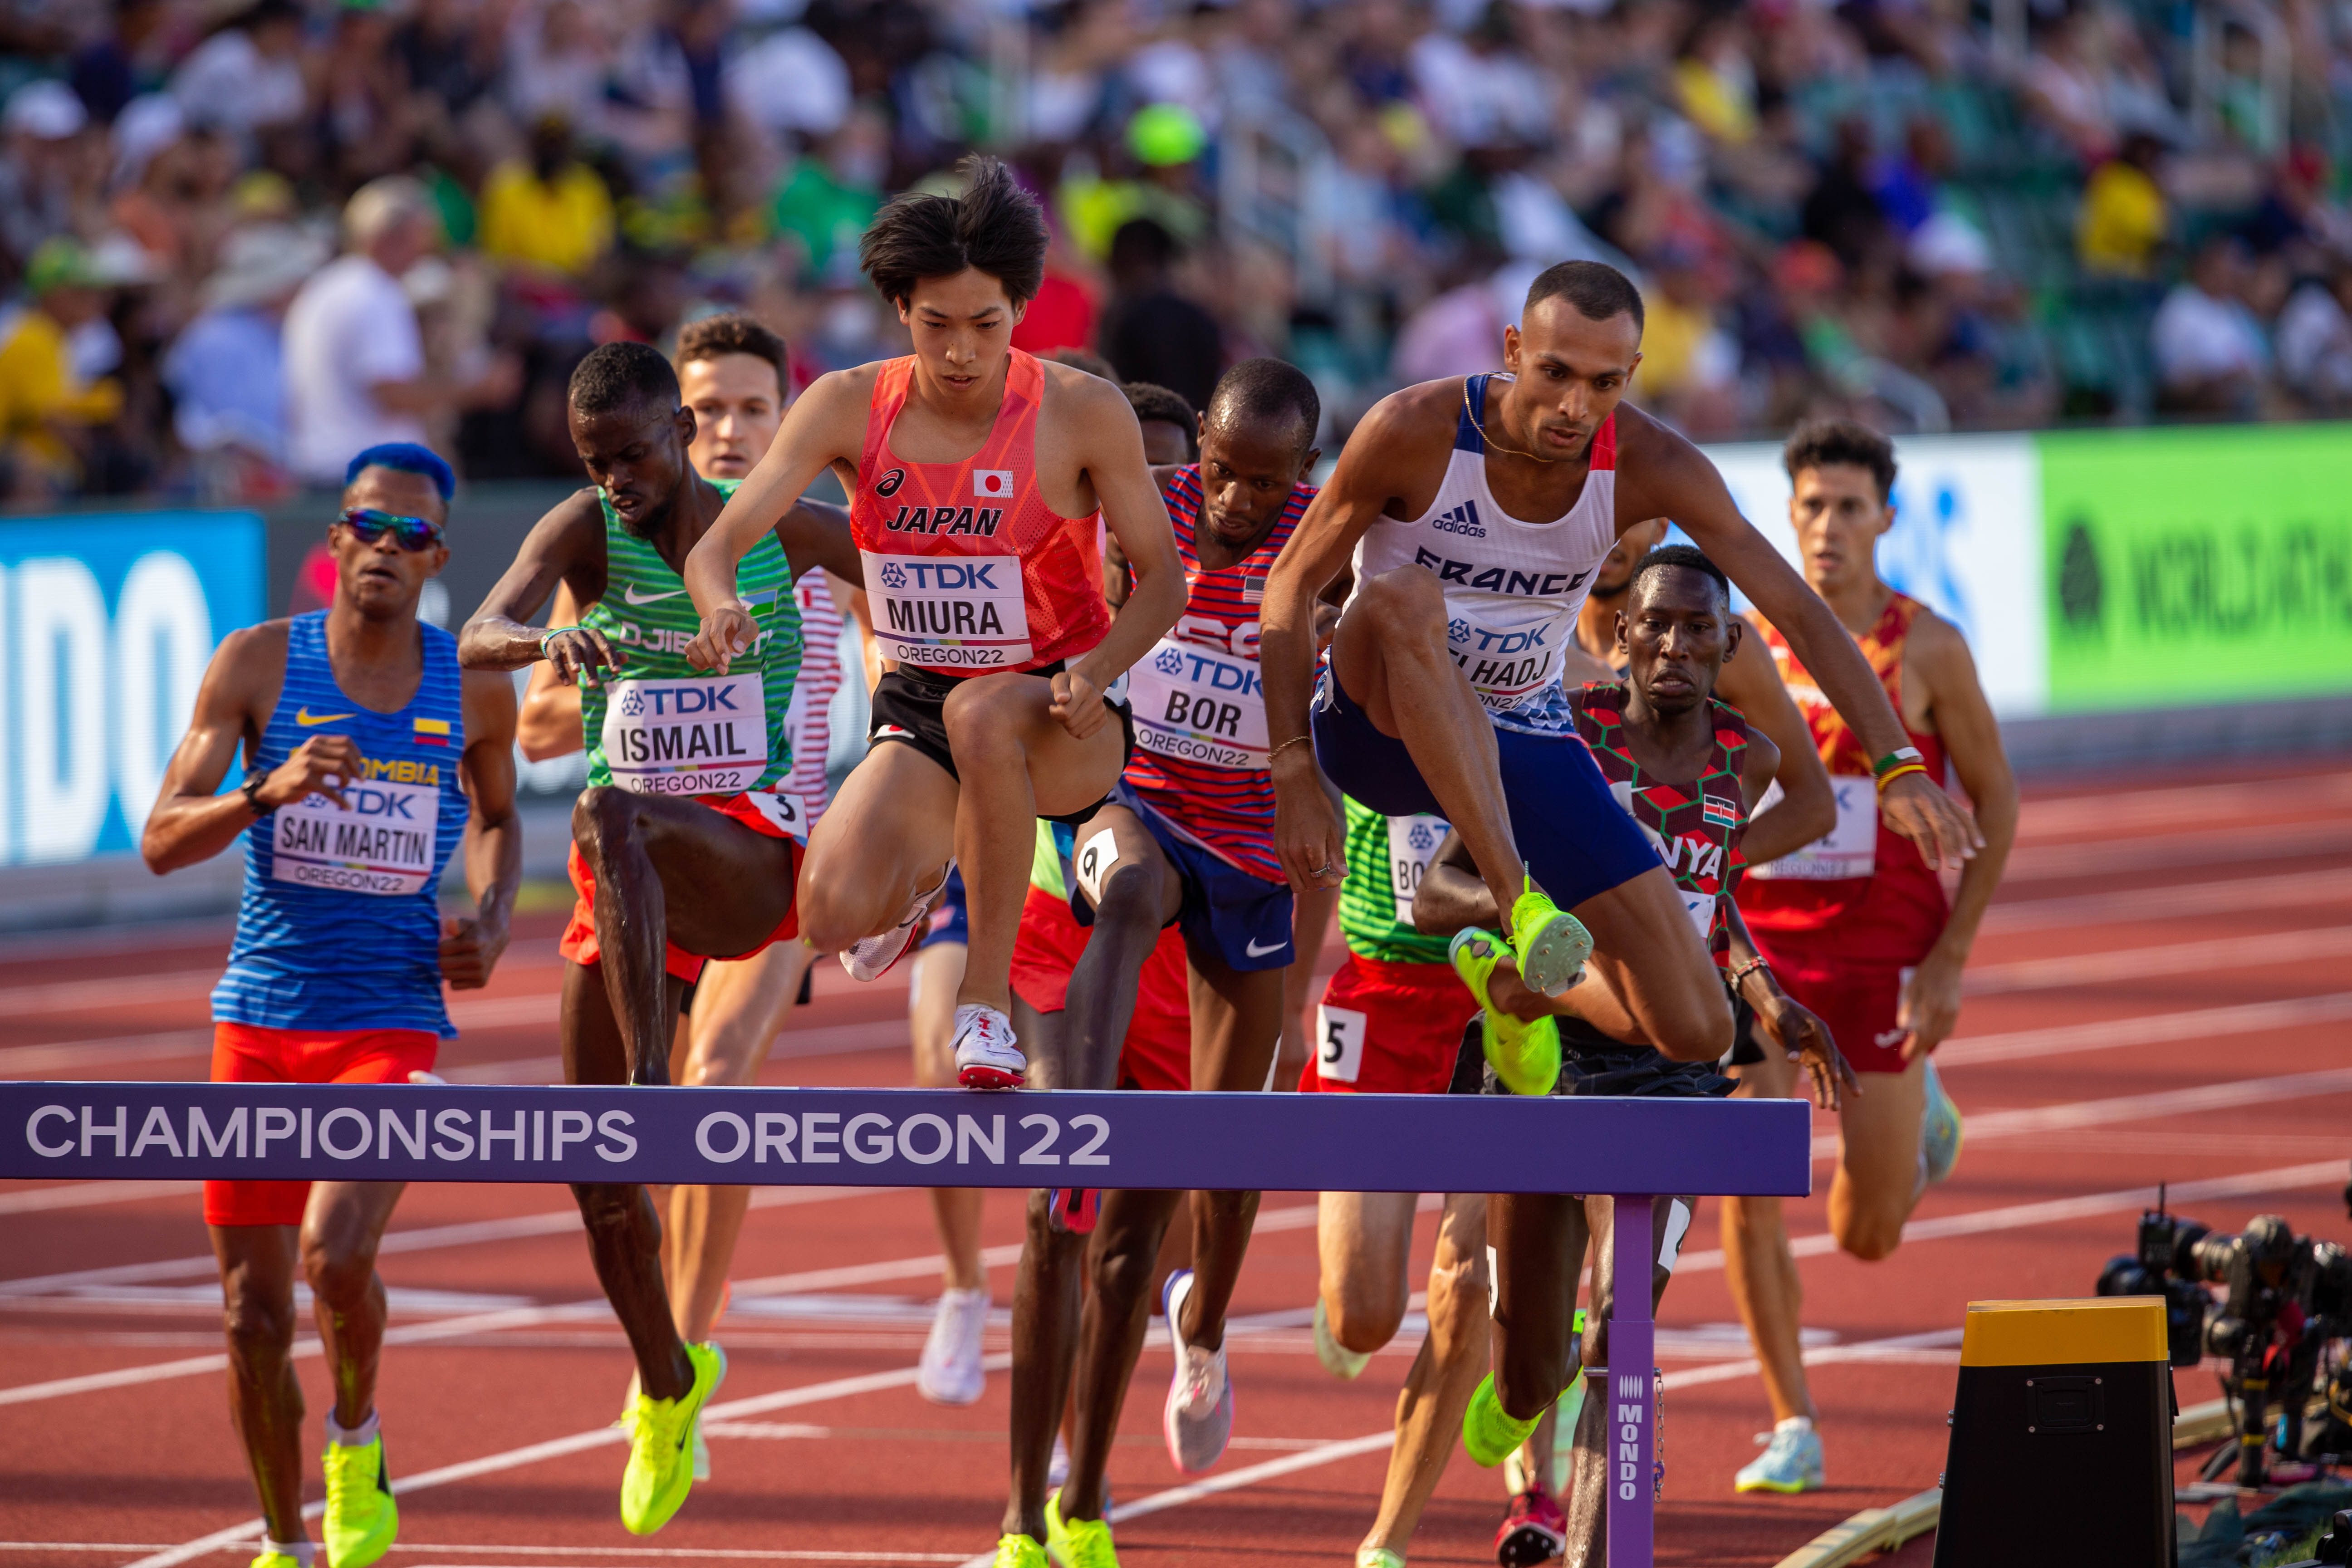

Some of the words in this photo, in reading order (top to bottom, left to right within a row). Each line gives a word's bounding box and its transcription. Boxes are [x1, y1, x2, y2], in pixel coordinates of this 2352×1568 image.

[886, 506, 1003, 537] JAPAN
[1432, 517, 1486, 538] adidas
[905, 563, 1000, 589] TDK
[1415, 545, 1593, 595] FRANCE
[886, 598, 1004, 635] MIURA
[897, 645, 1004, 664] OREGON22
[1475, 622, 1553, 653] TDK
[1186, 653, 1263, 699] TDK
[1470, 651, 1551, 686] HADJ
[644, 684, 739, 715] TDK
[1164, 690, 1242, 738] BOR
[621, 722, 746, 762] ISMAIL
[1139, 729, 1250, 766] OREGON22
[632, 772, 741, 794] OREGON22
[281, 816, 328, 854] SAN
[335, 822, 428, 864] MARTIN
[1652, 836, 1723, 881] NYA
[294, 865, 404, 892] OREGON22
[1083, 847, 1098, 884] 9
[1324, 1020, 1346, 1063] 5
[25, 1104, 637, 1163] CHAMPIONSHIPS
[1617, 1404, 1642, 1501] MONDO
